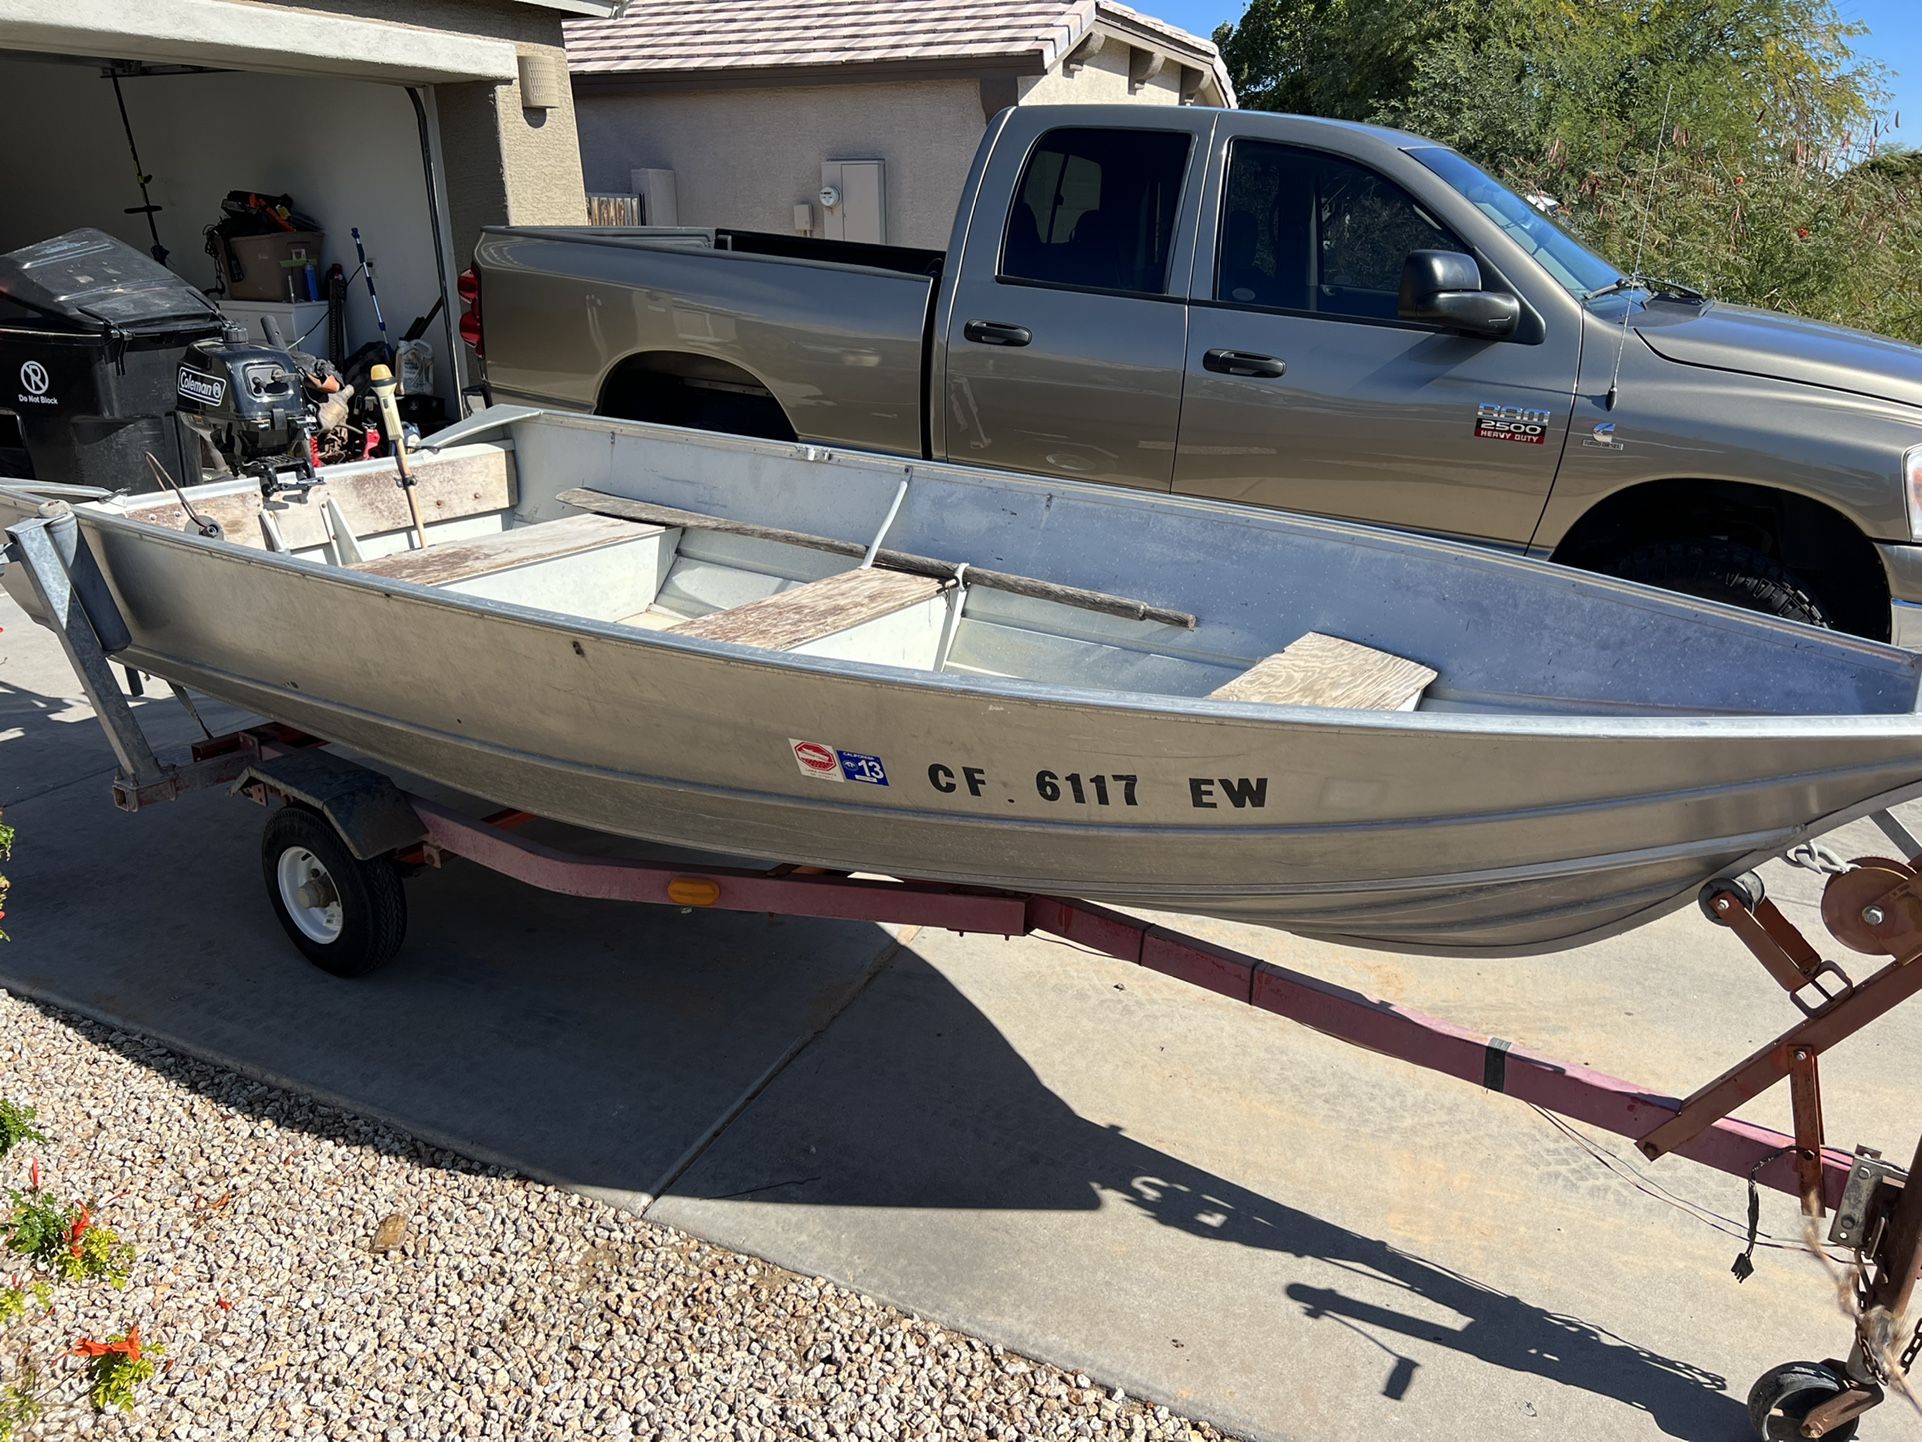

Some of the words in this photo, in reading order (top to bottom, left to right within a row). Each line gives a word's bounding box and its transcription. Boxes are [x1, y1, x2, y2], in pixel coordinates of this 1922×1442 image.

[180, 371, 212, 396] Coleman
[18, 394, 28, 402] Do
[28, 395, 40, 403] Not
[40, 396, 58, 404] Block
[1480, 419, 1542, 435] 2500
[1480, 430, 1511, 440] HEAVY
[1514, 434, 1540, 443] DUTY
[858, 760, 884, 779] 13
[927, 763, 987, 797] CF
[1035, 769, 1139, 807] 6117
[1188, 777, 1268, 809] EW
